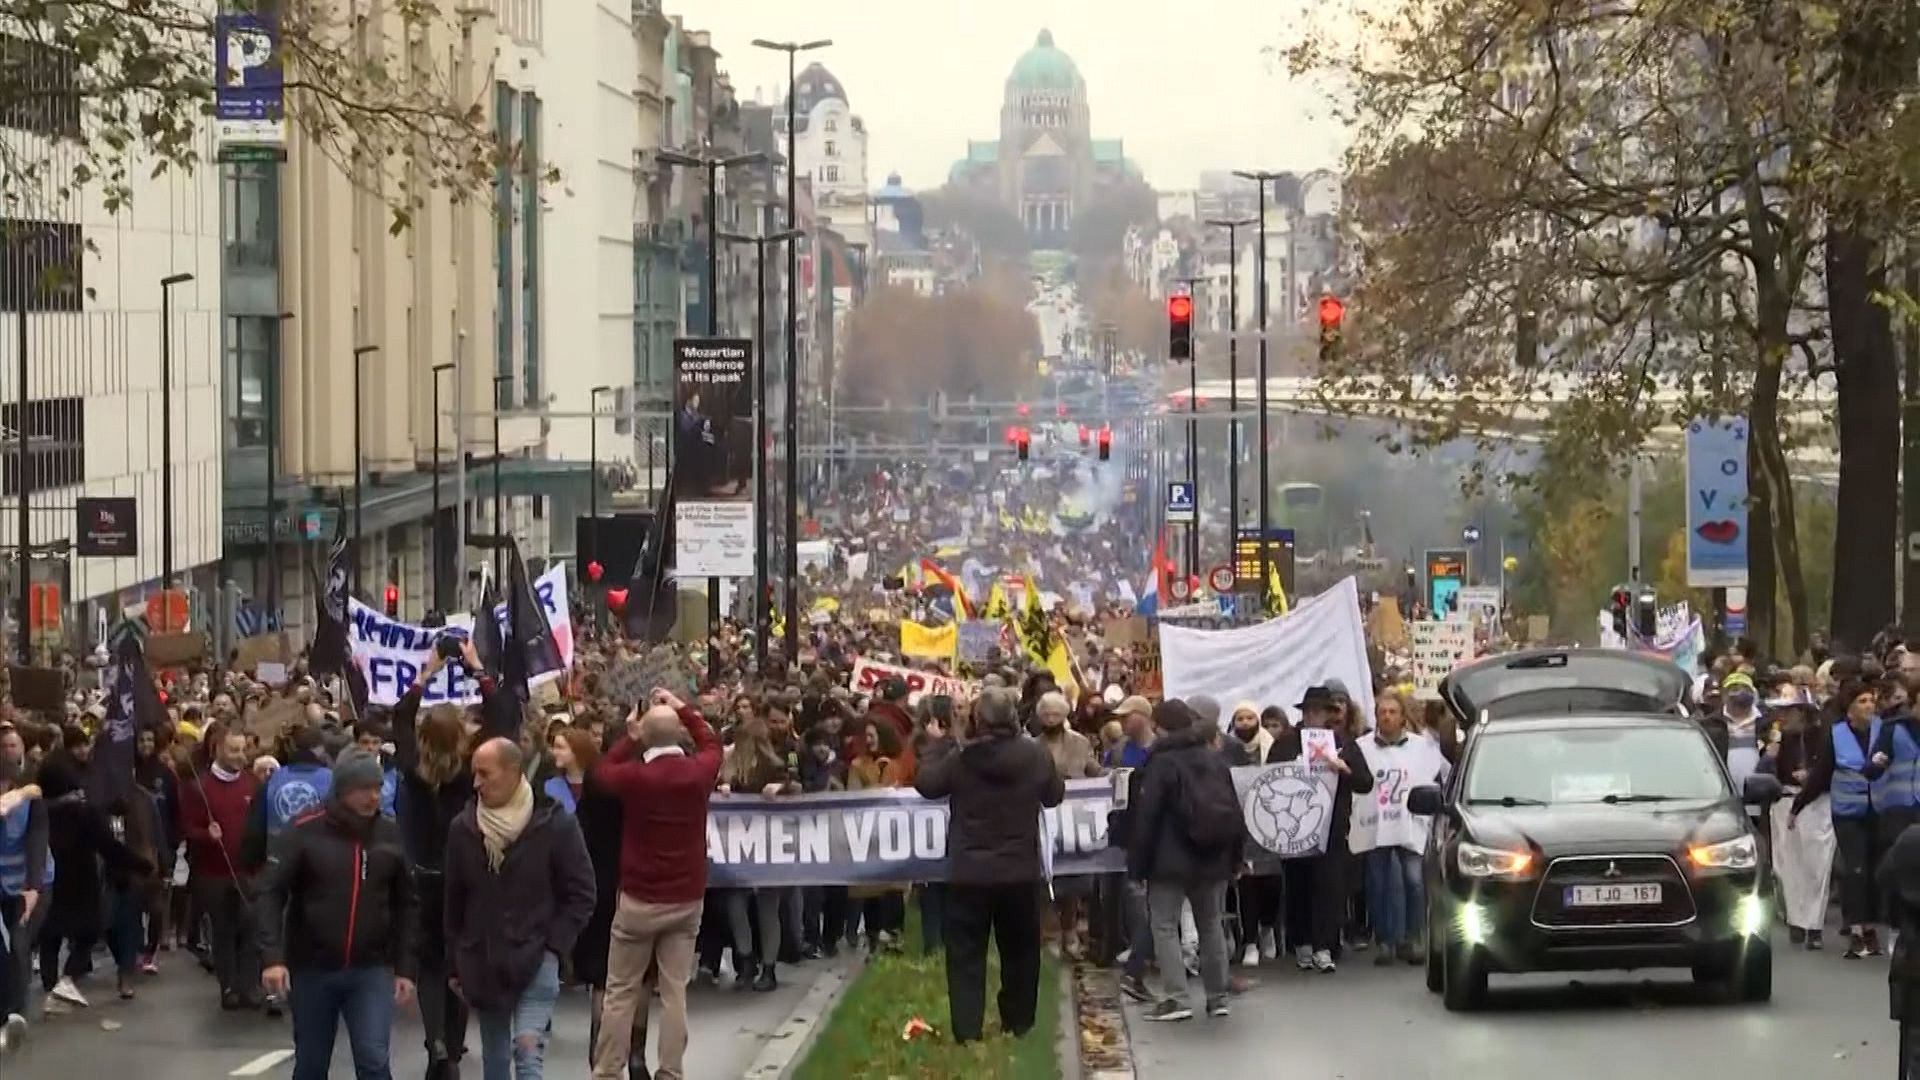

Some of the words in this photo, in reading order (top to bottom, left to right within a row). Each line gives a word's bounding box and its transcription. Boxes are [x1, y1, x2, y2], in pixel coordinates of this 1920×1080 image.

[227, 30, 271, 87] P
[681, 359, 745, 370] excellence
[681, 371, 692, 382] at
[695, 371, 710, 382] its
[707, 811, 829, 865] AMEN
[843, 808, 946, 863] VOO
